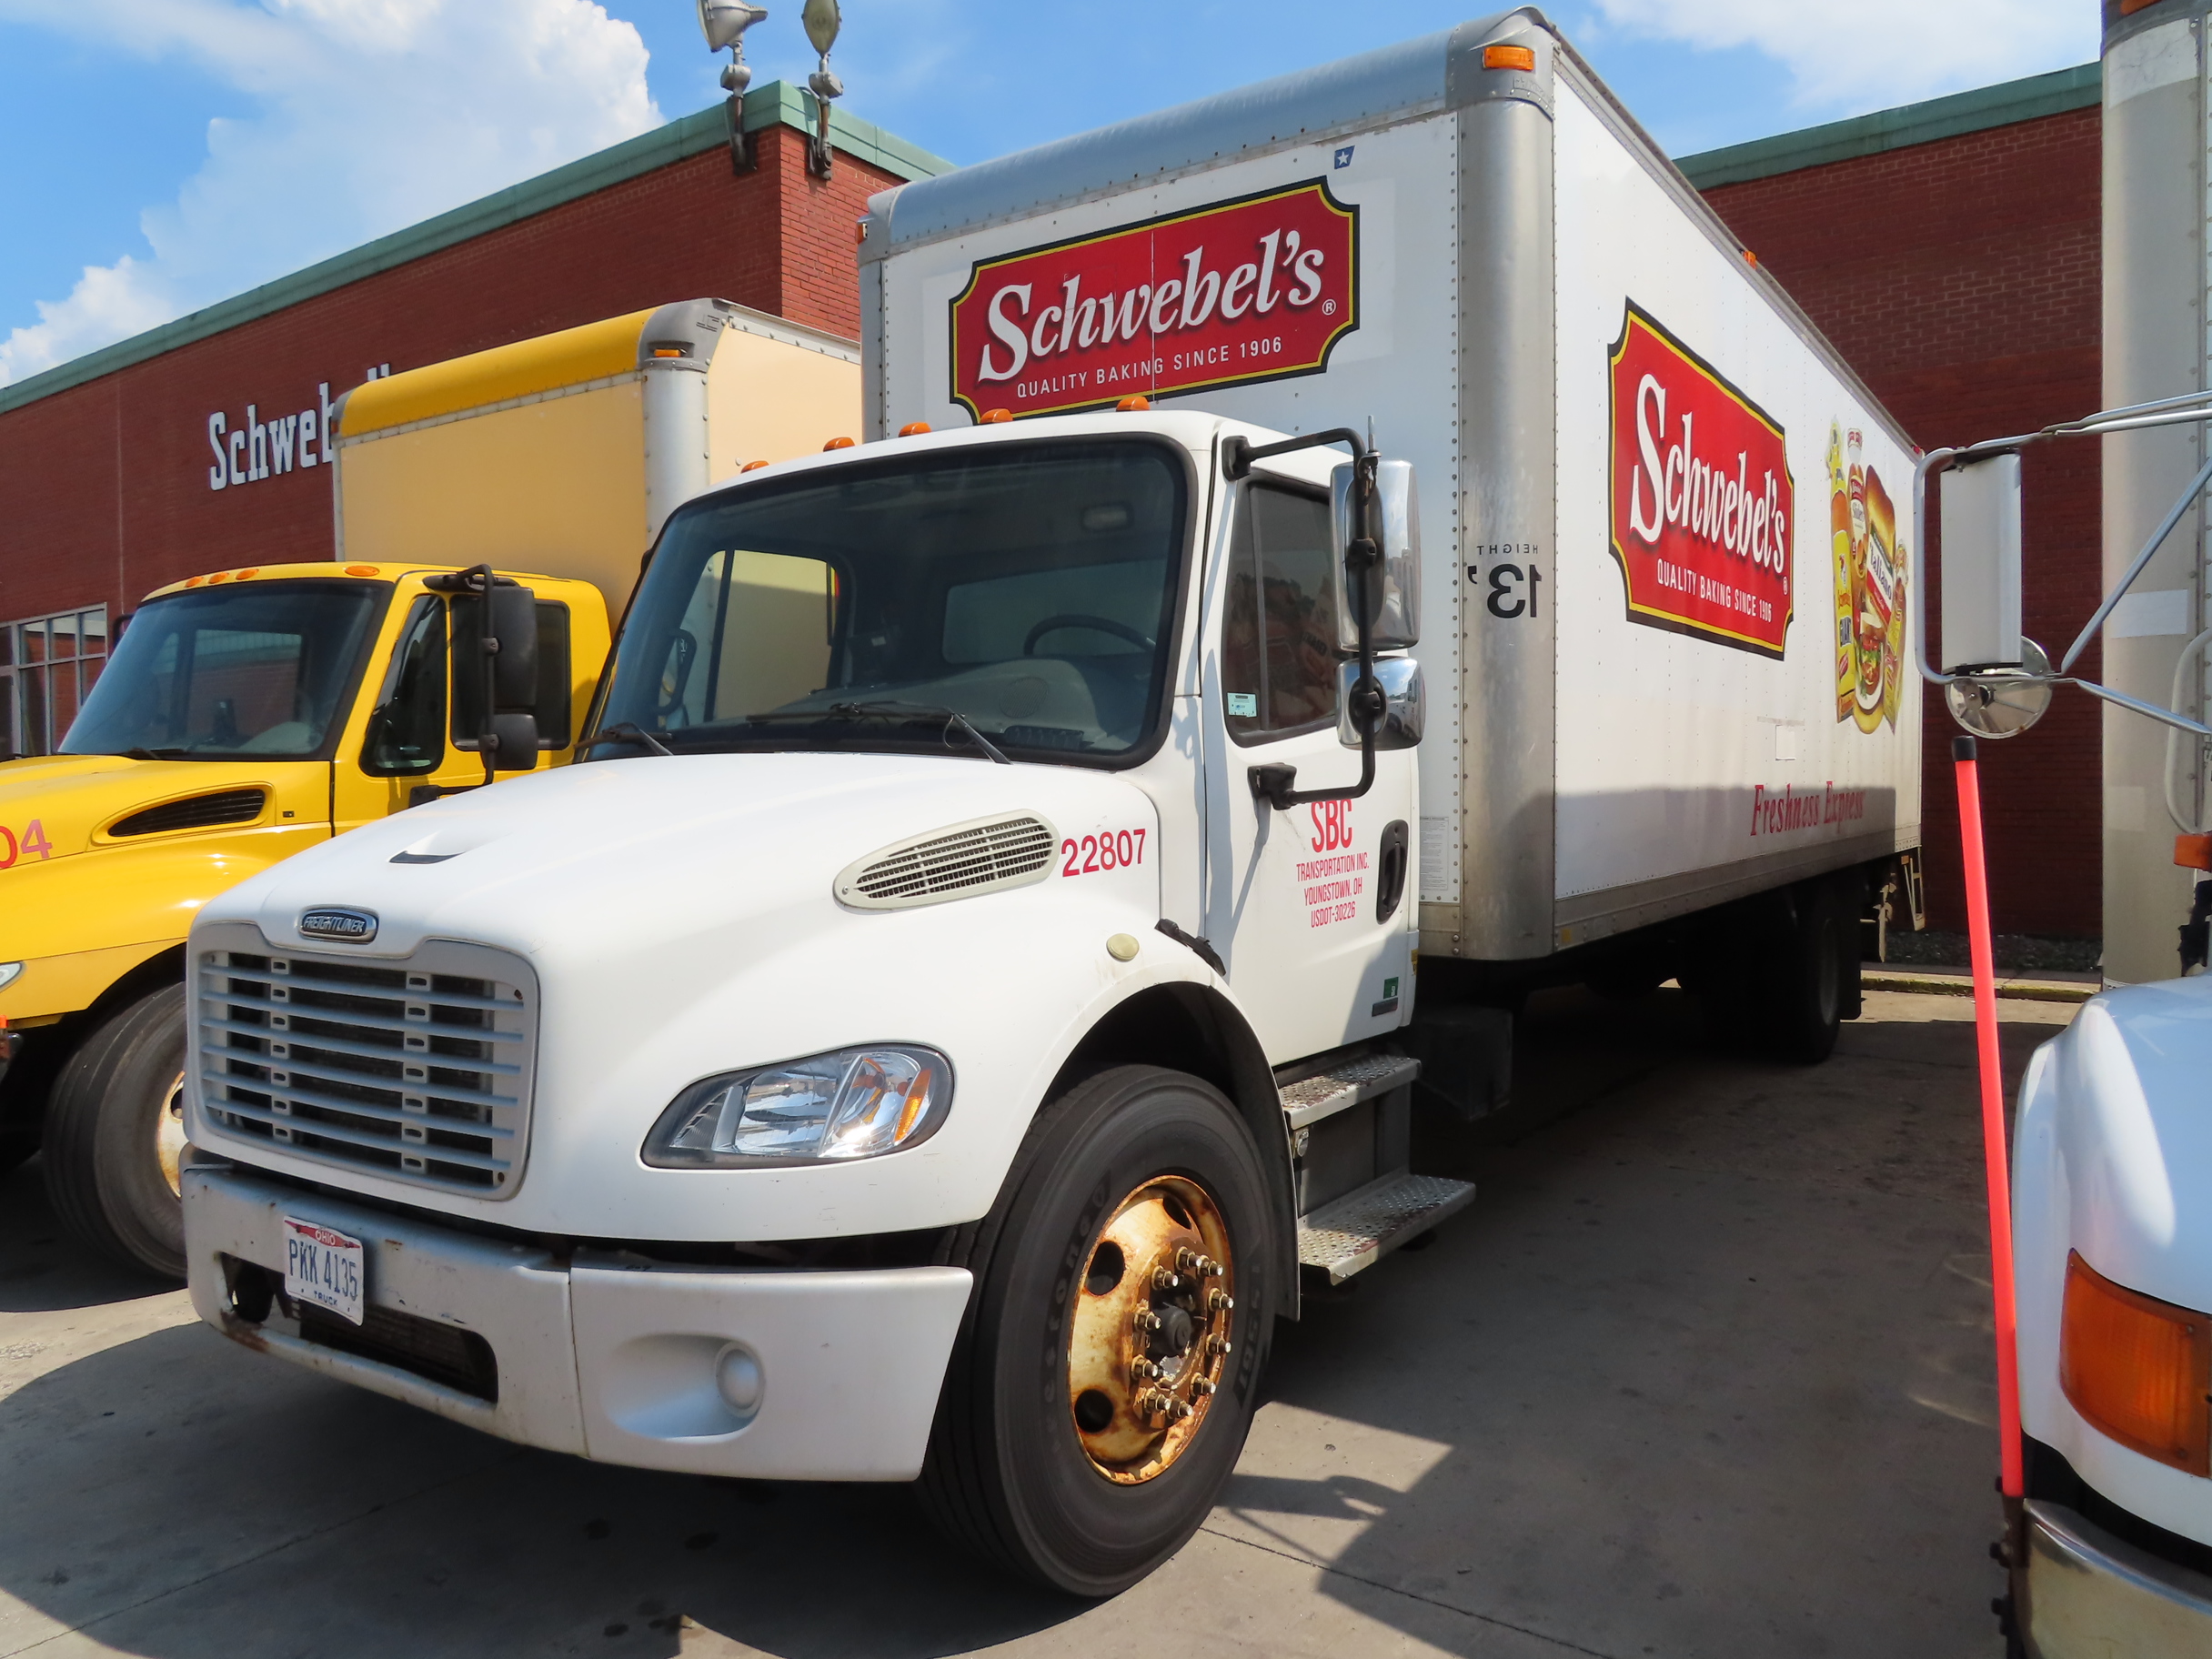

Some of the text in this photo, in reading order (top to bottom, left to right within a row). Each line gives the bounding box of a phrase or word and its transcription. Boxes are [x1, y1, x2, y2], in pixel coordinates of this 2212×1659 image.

[978, 227, 1325, 382] Schwebel's
[1017, 336, 1282, 398] QUALITY BAKING SINCE 1906
[1629, 373, 1785, 574] Schwebel's
[1657, 558, 1773, 623] QUALITY BAKING SINCE 1906
[1311, 799, 1353, 853] SBC
[1750, 780, 1866, 837] Freshness Express
[1061, 828, 1146, 878] 22807
[1296, 851, 1370, 882] TRANSPORTATION INC.
[1303, 876, 1363, 906] YOUNGSTOWN, OH
[1311, 900, 1356, 929] USDOT-30226
[303, 915, 366, 933] FREIGHTLINER
[315, 1230, 336, 1246] OHIO
[288, 1238, 358, 1302] PKK 4135
[313, 1290, 338, 1307] TRUCK
